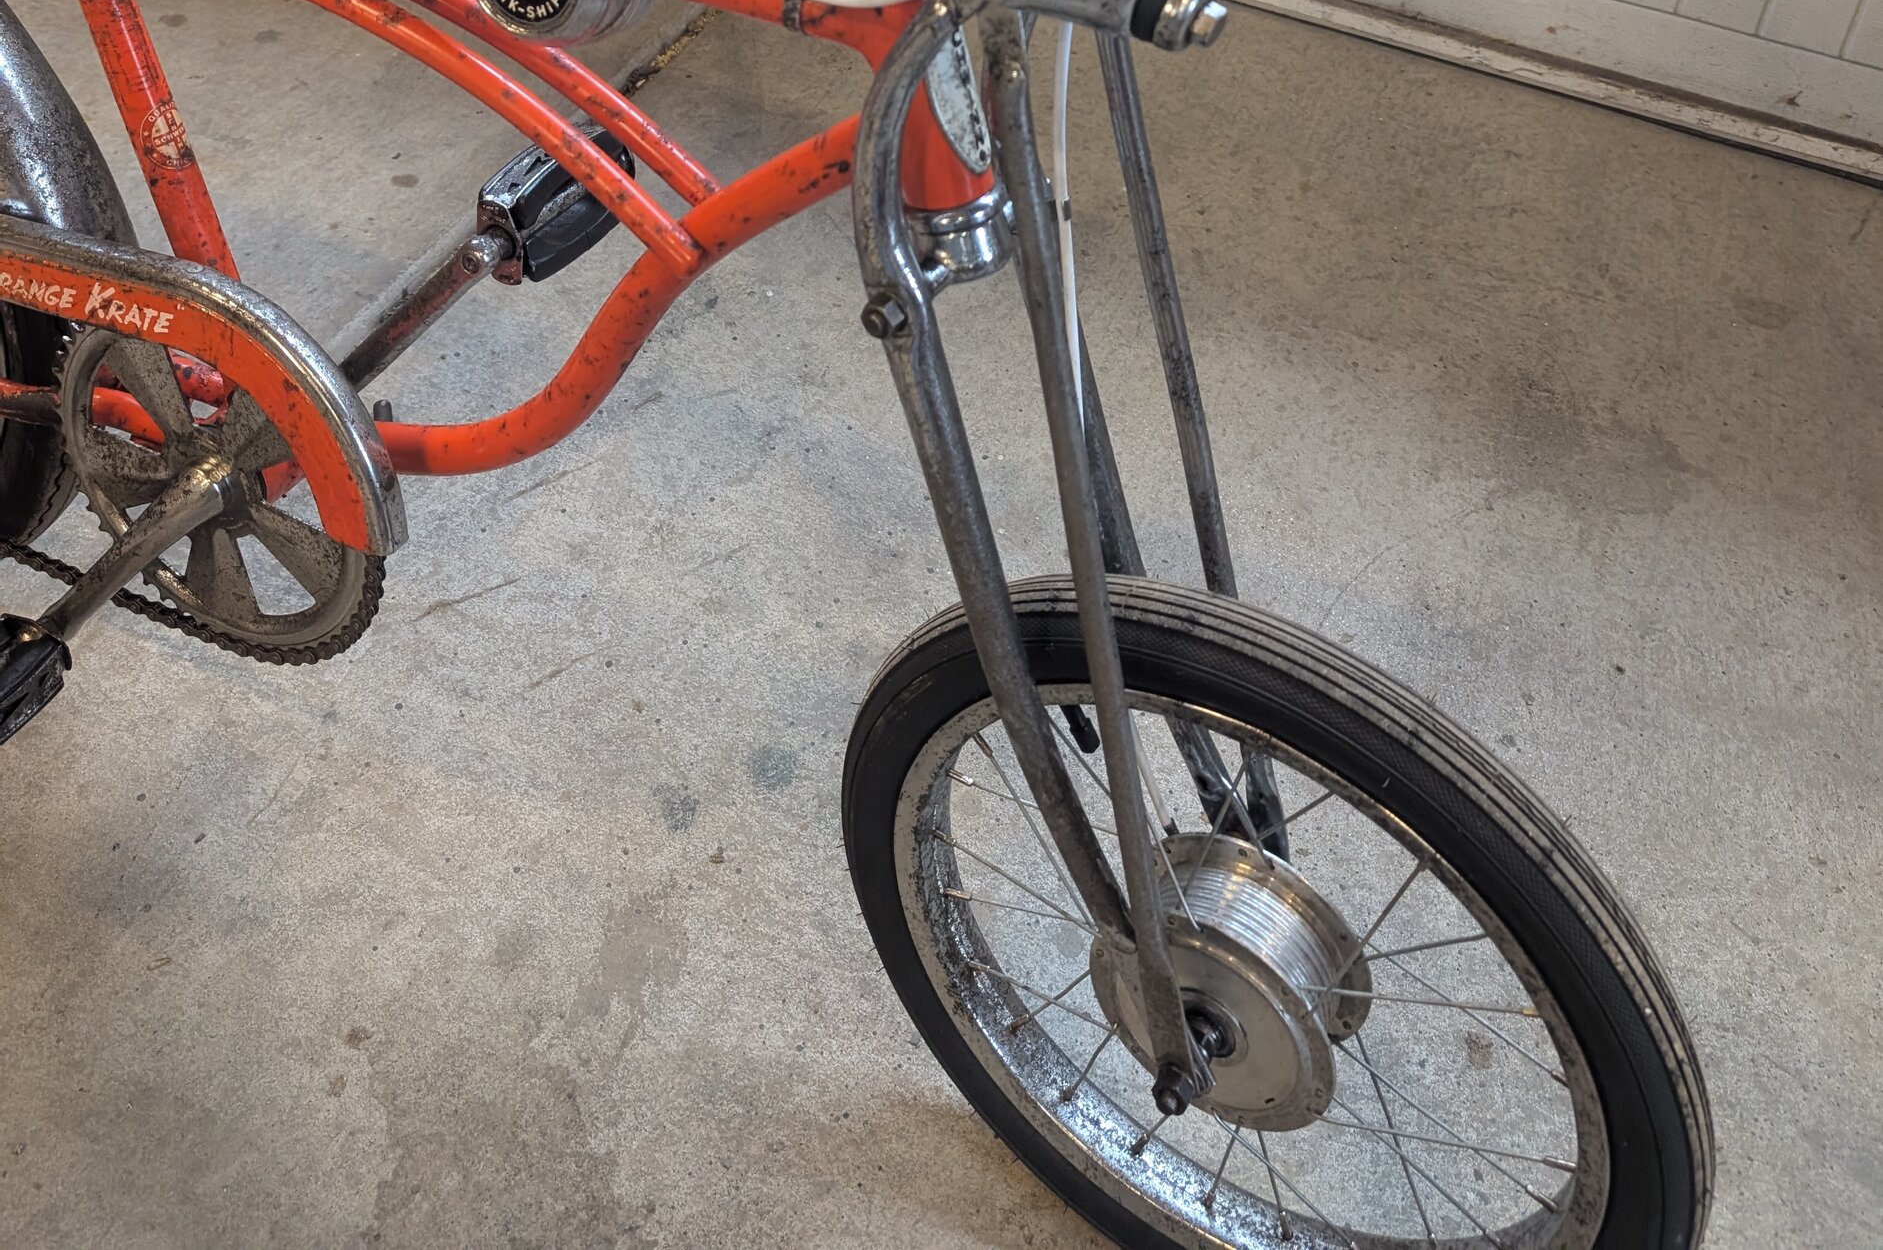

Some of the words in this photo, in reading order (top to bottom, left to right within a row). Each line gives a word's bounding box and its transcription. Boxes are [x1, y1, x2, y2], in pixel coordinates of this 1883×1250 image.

[951, 28, 985, 151] CHWINN
[148, 102, 176, 122] QUALI
[166, 157, 189, 166] CHIC
[0, 271, 77, 308] RANGE
